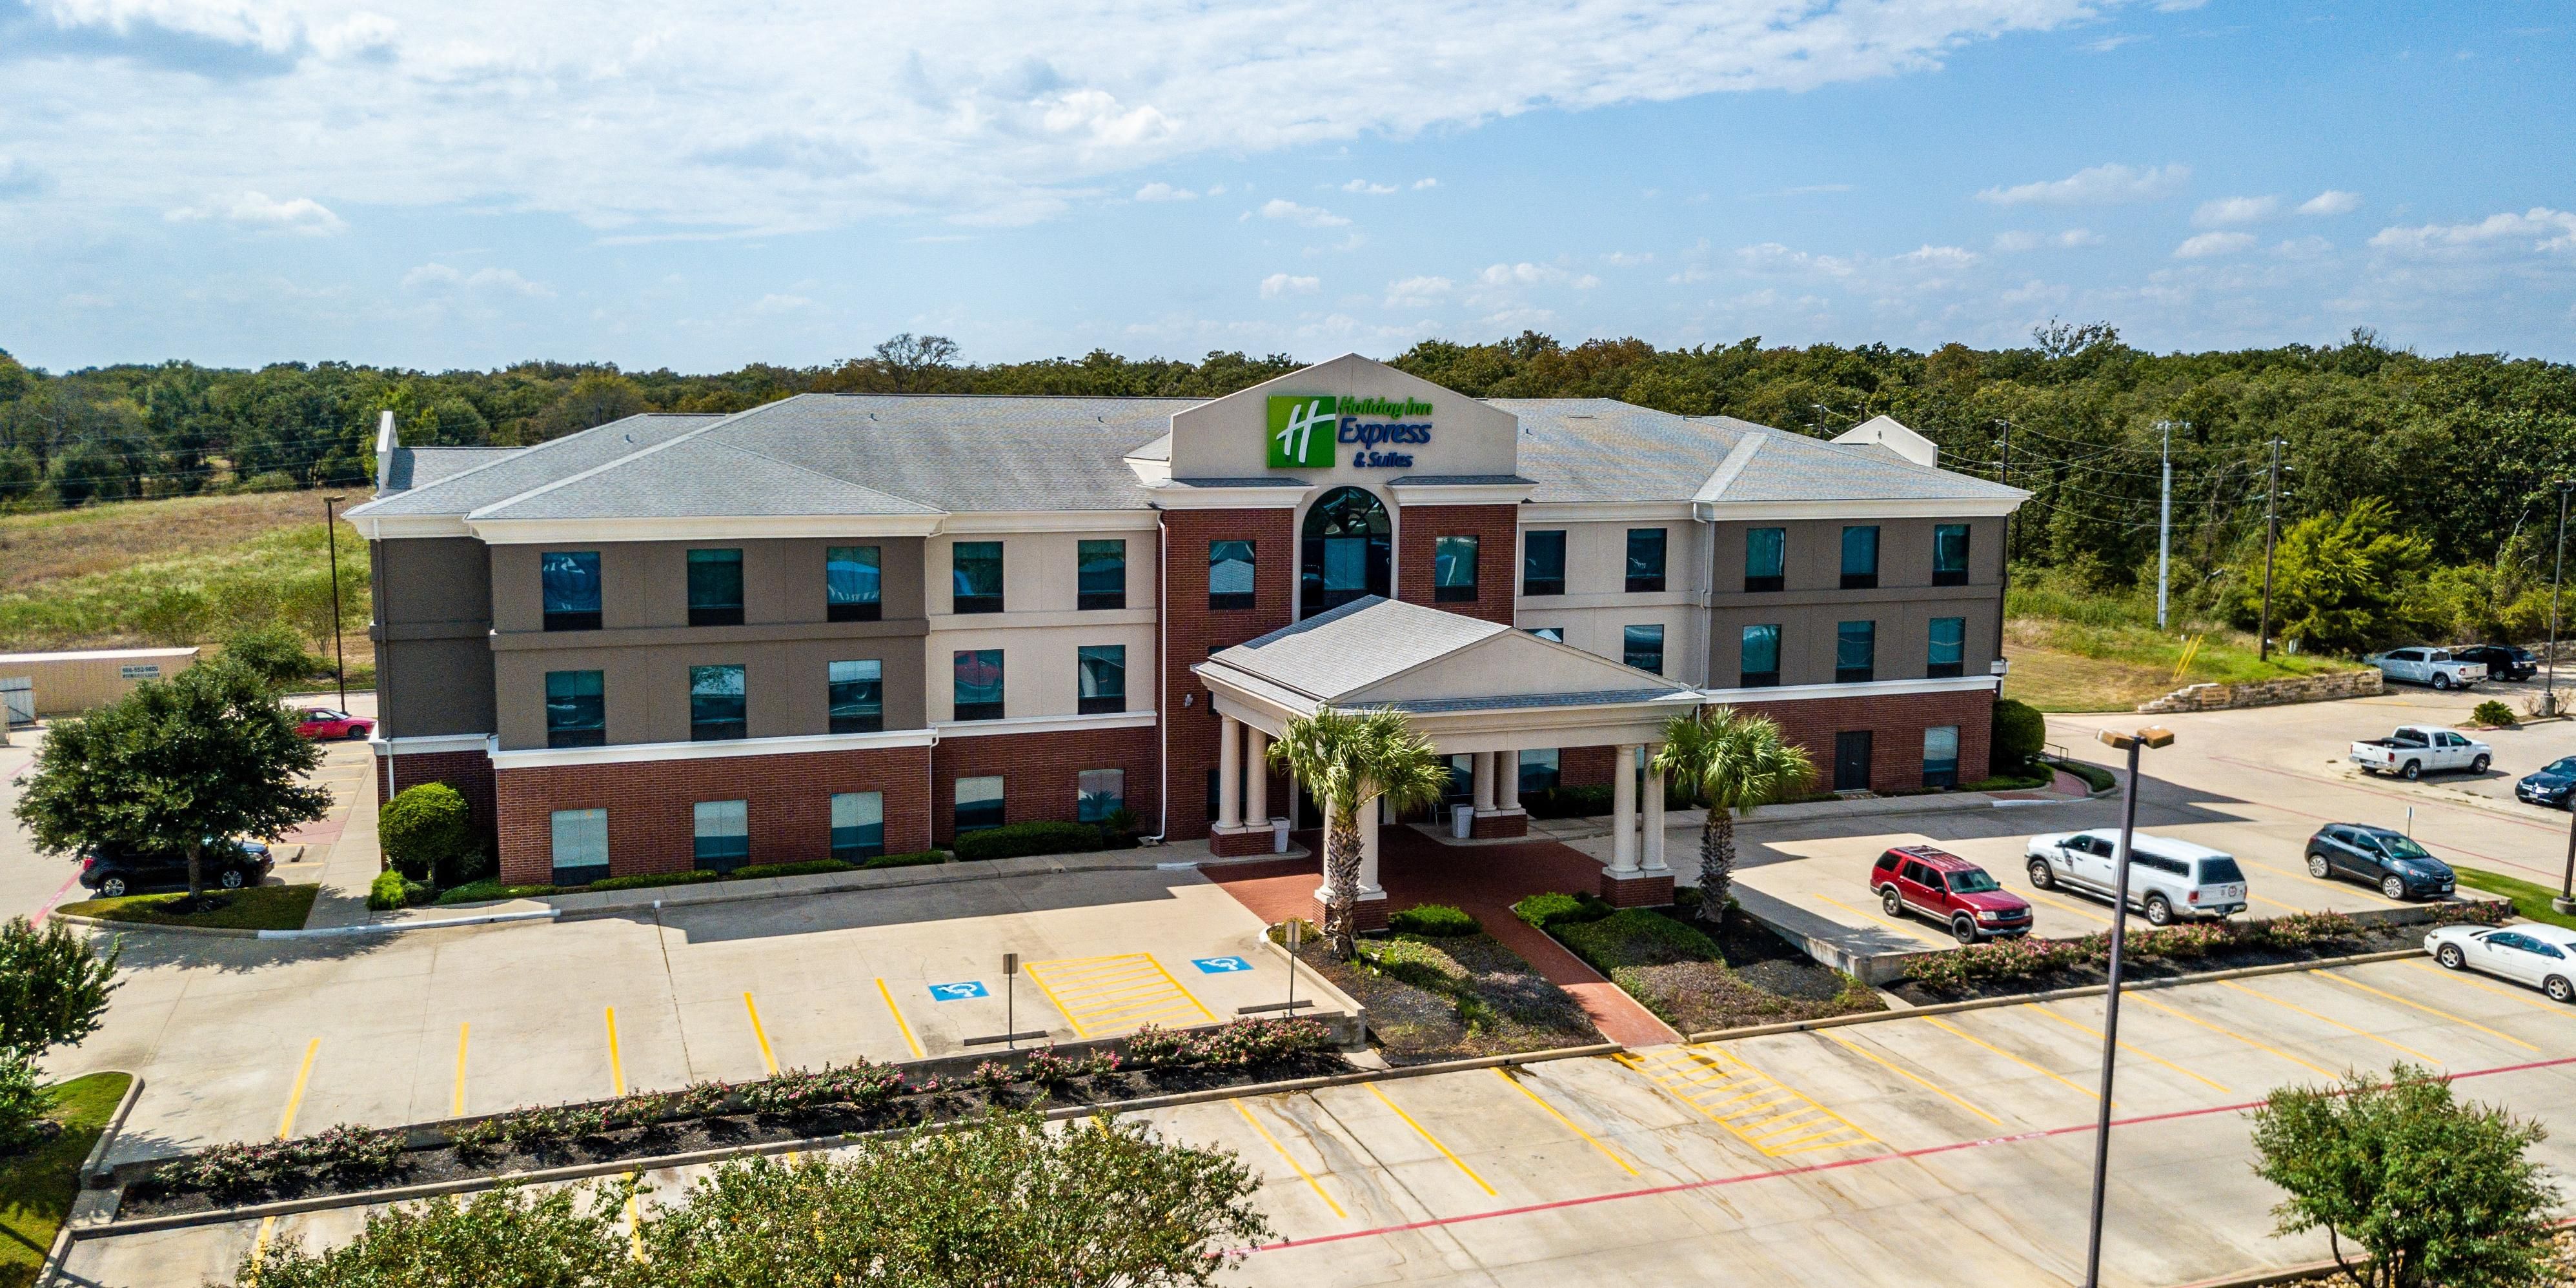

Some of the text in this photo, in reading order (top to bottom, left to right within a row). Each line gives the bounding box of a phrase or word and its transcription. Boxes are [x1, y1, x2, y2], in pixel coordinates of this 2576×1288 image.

[1339, 396, 1433, 419] Holiday Inn
[1276, 399, 1335, 463] H
[1338, 418, 1432, 450] Express
[1353, 452, 1414, 468] & Suites
